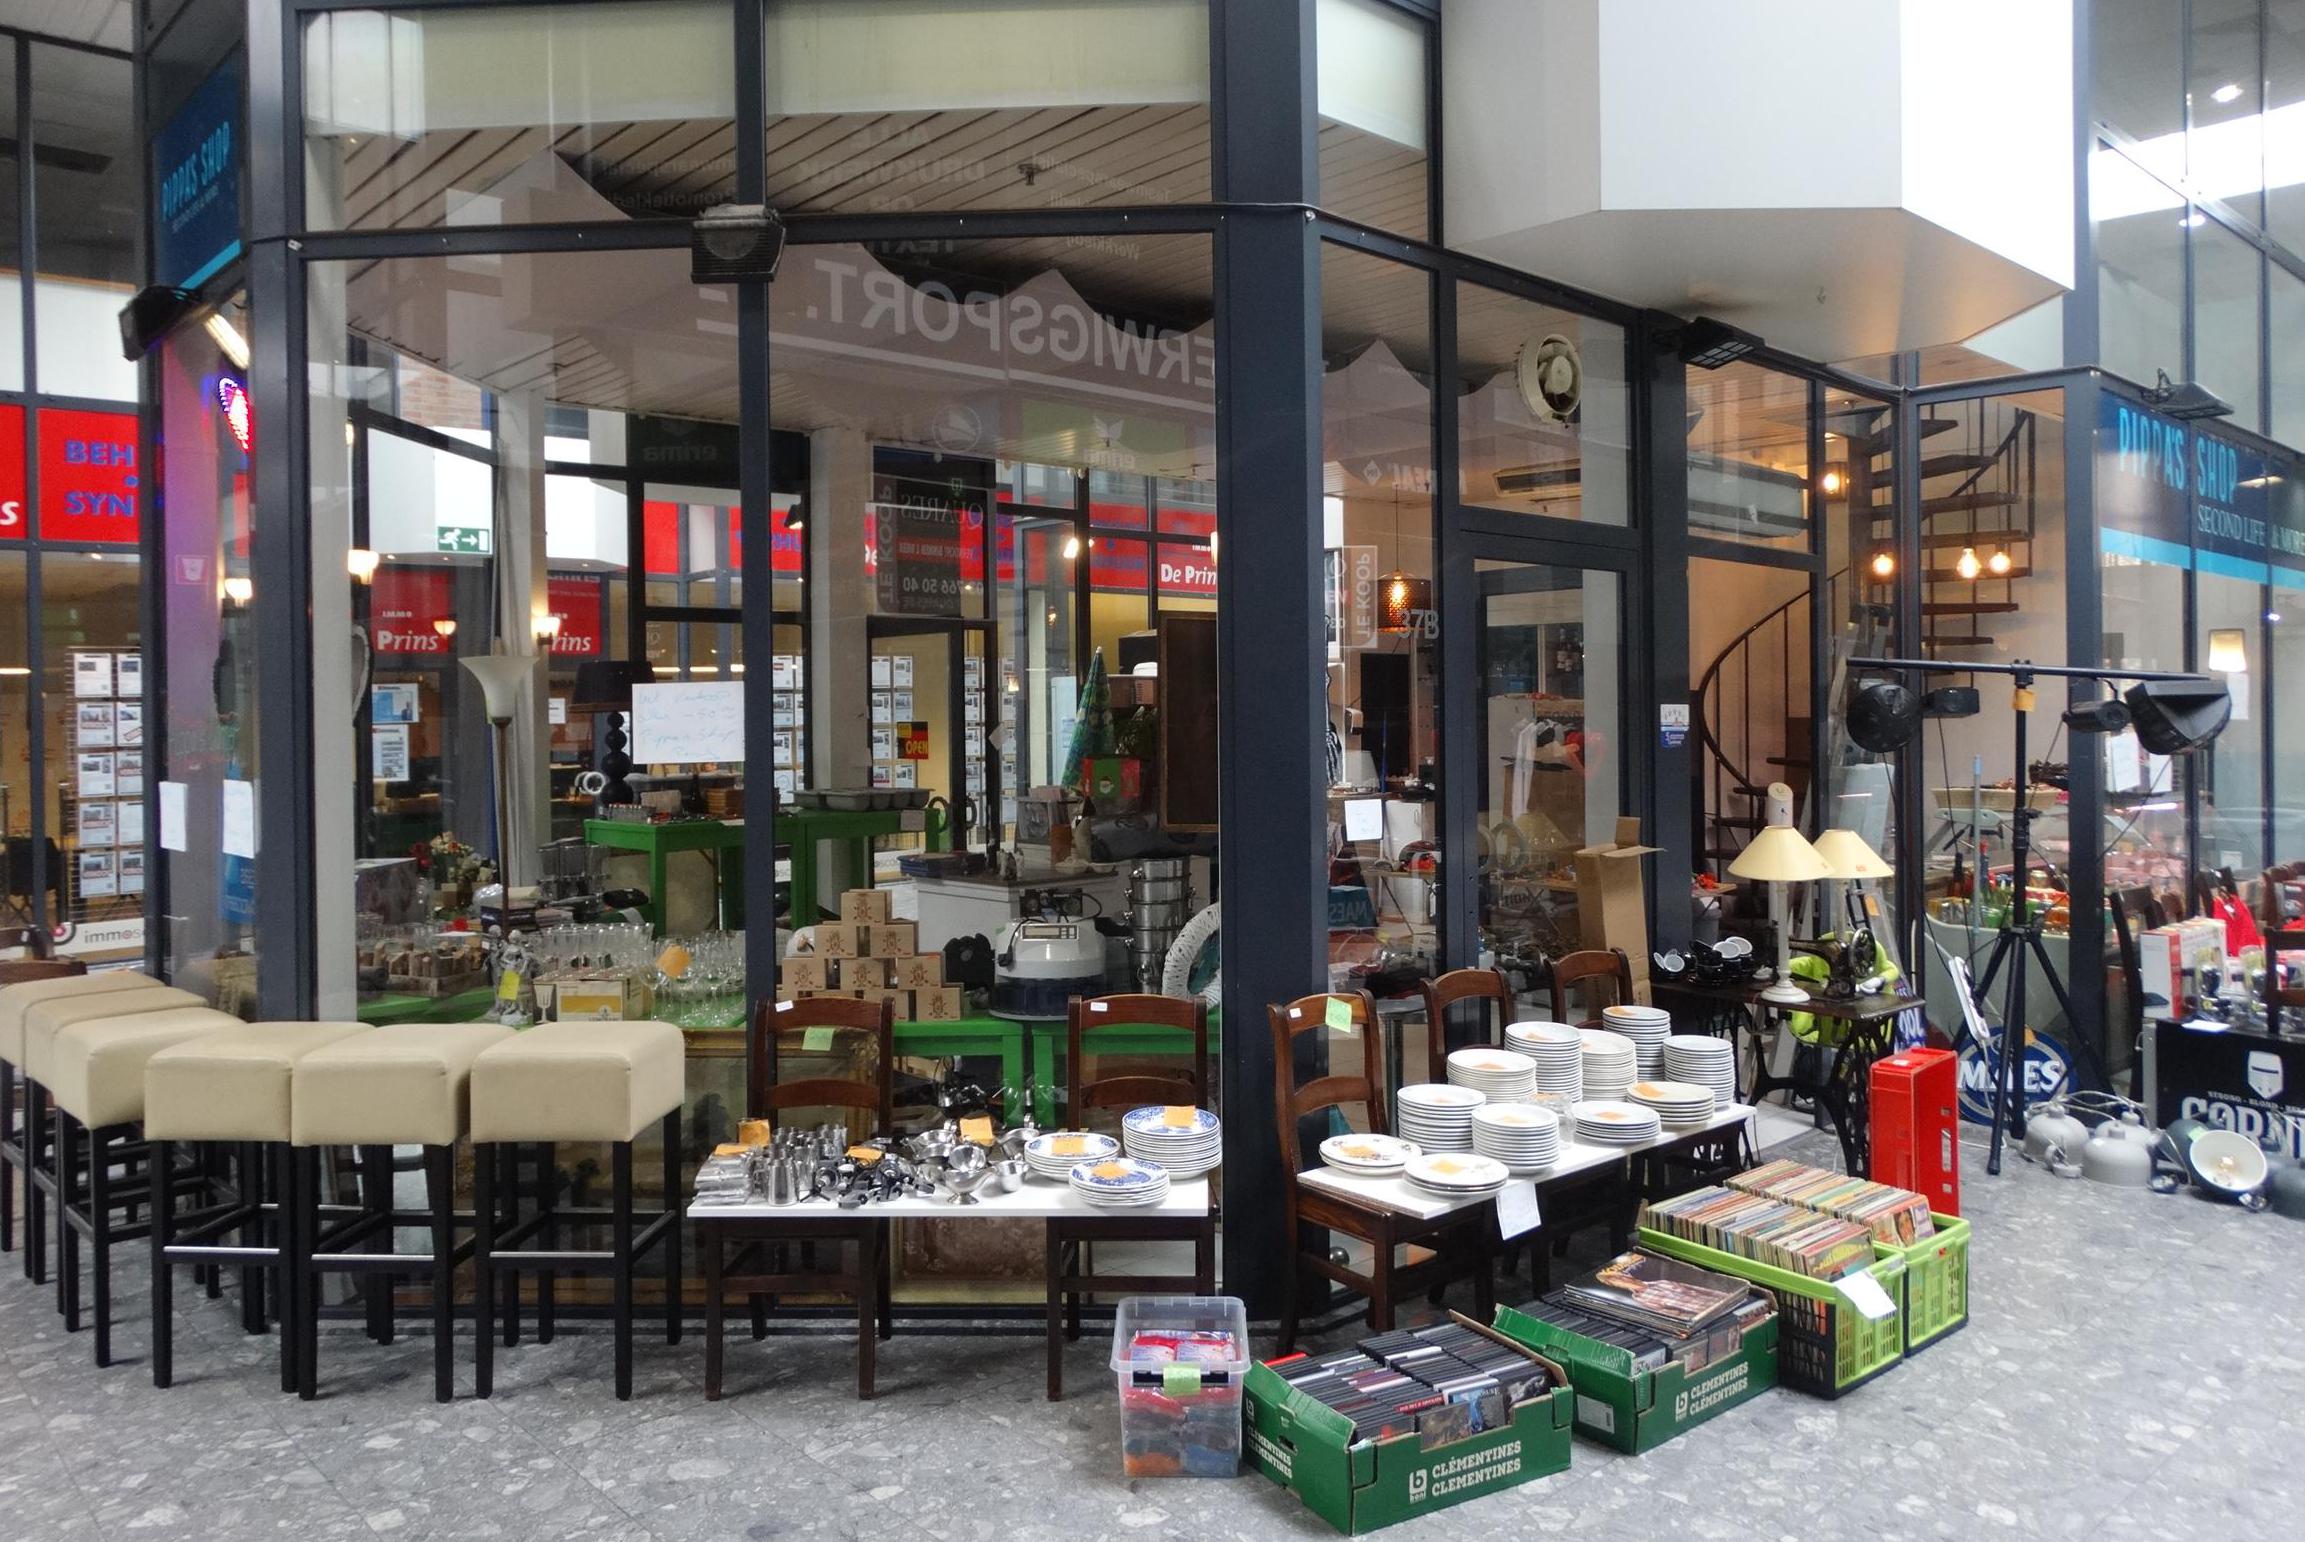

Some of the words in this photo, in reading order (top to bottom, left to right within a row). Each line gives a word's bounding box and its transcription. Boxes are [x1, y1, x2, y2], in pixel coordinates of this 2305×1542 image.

[200, 121, 231, 186] SHOP
[2118, 407, 2185, 490] PIPPA'S
[2196, 436, 2239, 504] SHOP
[2197, 504, 2243, 541] SECOND
[2243, 516, 2266, 546] LIFE
[1160, 563, 1181, 583] De
[377, 630, 439, 652] Prins
[551, 632, 592, 652] rins
[1395, 608, 1439, 641] 37B
[905, 740, 928, 756] OPEN
[1432, 1440, 1521, 1478] CLÉMENTINES
[1431, 1458, 1521, 1497] CLEMENTINES
